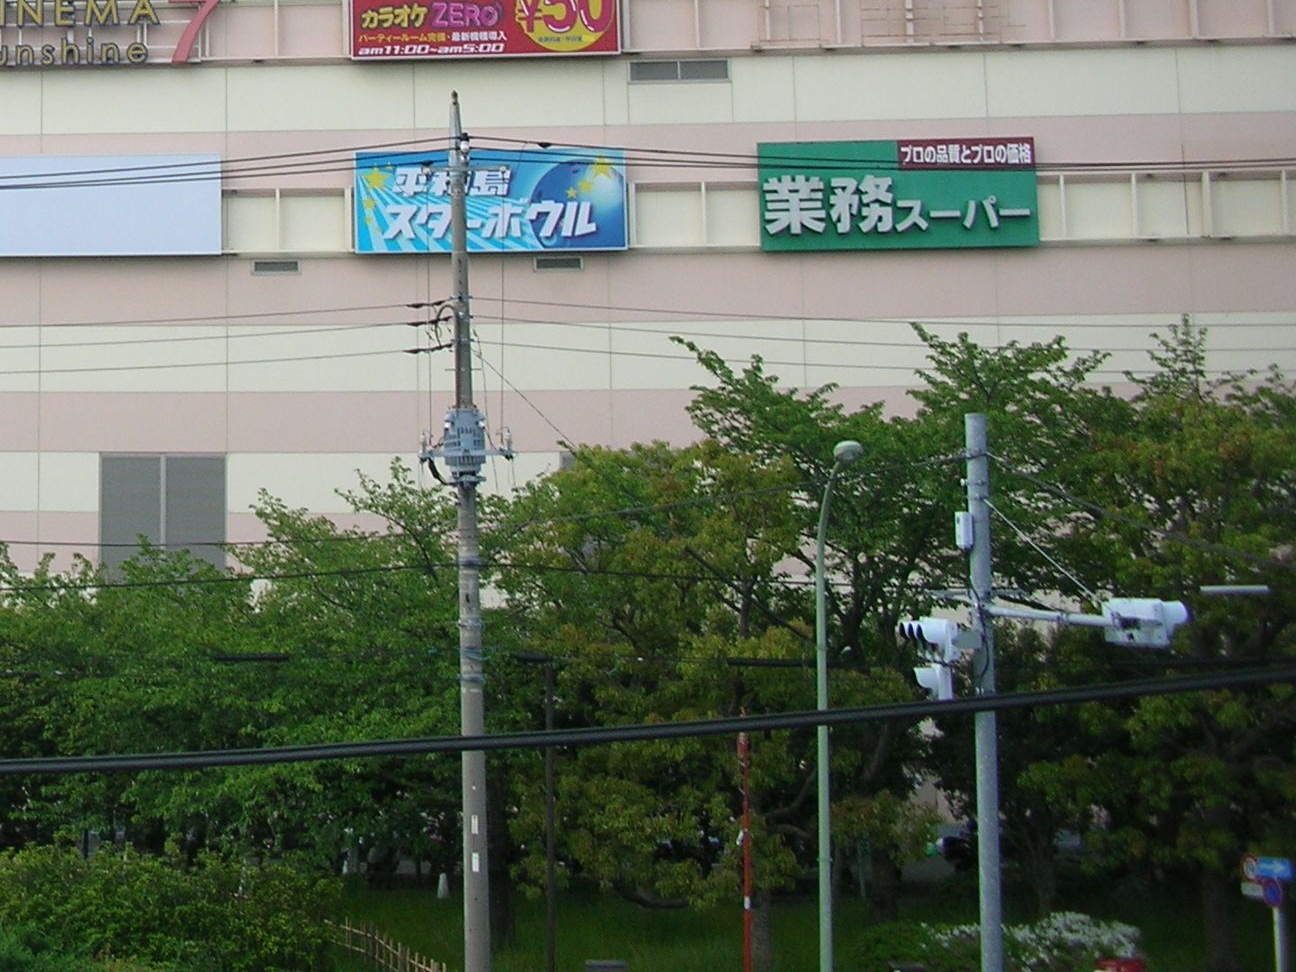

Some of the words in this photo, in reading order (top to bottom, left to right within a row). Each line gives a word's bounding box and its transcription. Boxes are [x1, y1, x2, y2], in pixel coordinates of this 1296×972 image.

[362, 3, 428, 28] カラオケ
[430, 2, 499, 28] ZERO
[900, 143, 1032, 164] プロの品質とプロの価格
[762, 175, 1031, 235] 業務スーパー
